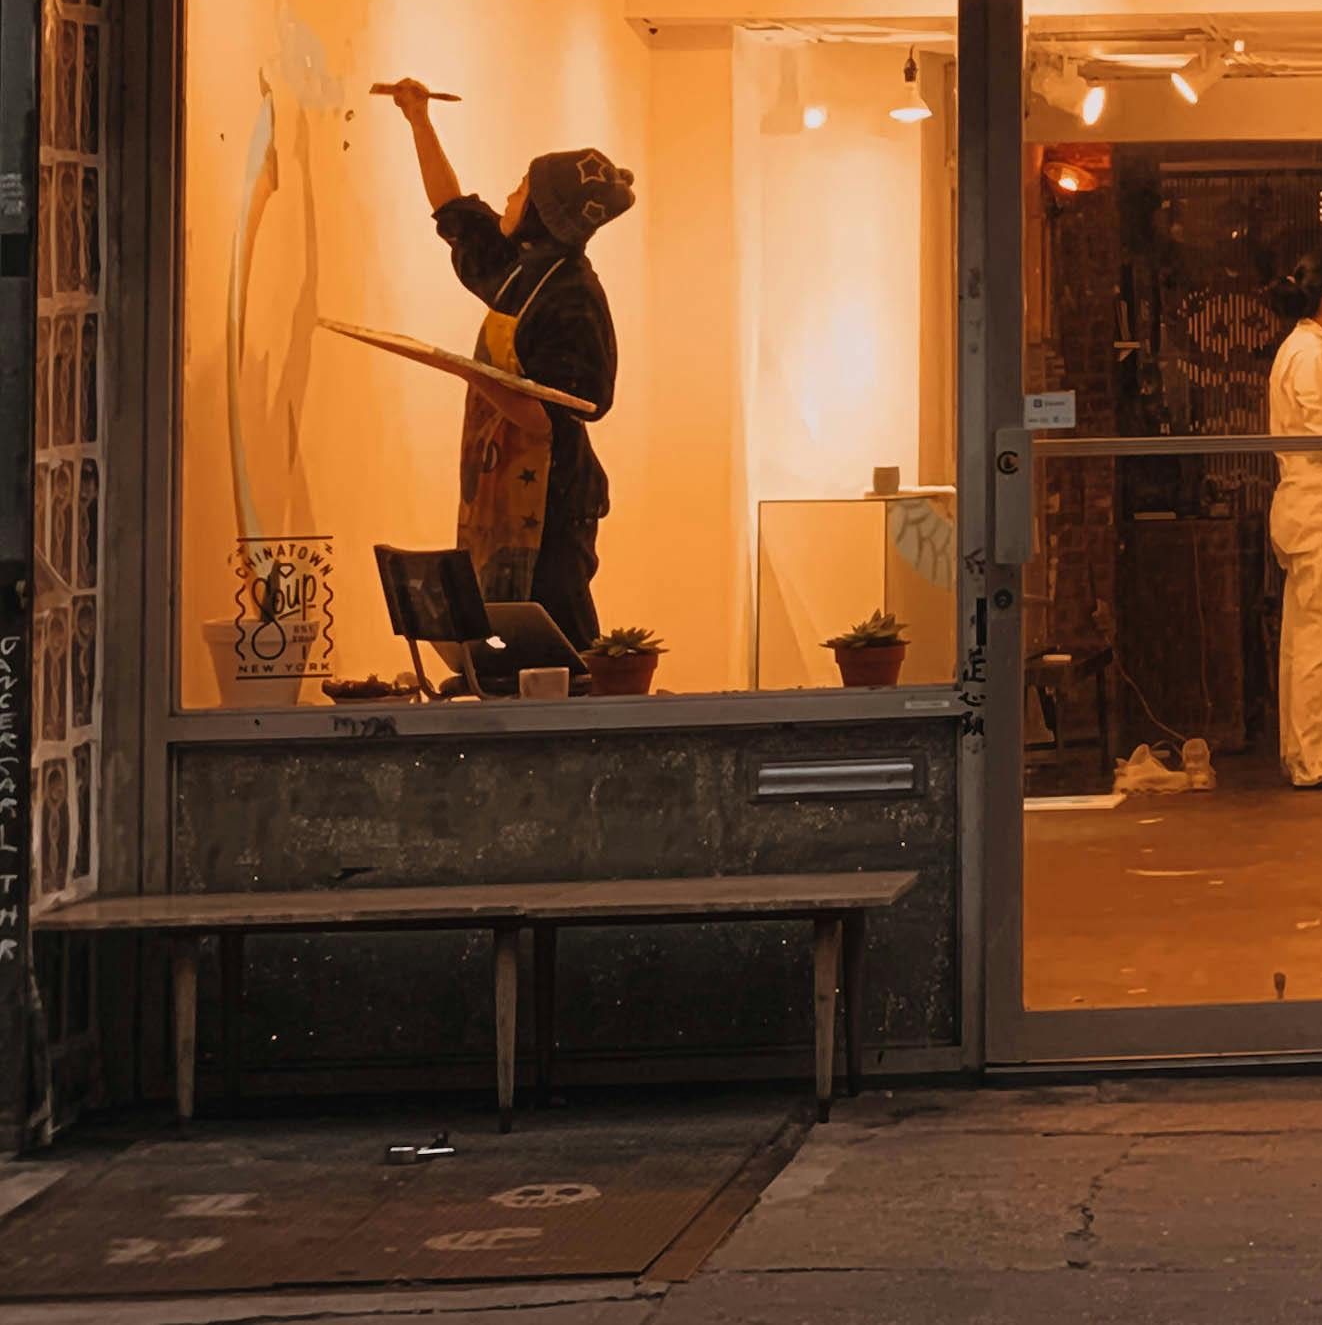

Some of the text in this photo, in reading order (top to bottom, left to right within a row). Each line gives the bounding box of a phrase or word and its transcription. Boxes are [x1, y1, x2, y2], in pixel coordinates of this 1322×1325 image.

[234, 543, 334, 580] CHINATOWN
[250, 573, 317, 661] Soup
[238, 662, 331, 673] NEW YORK
